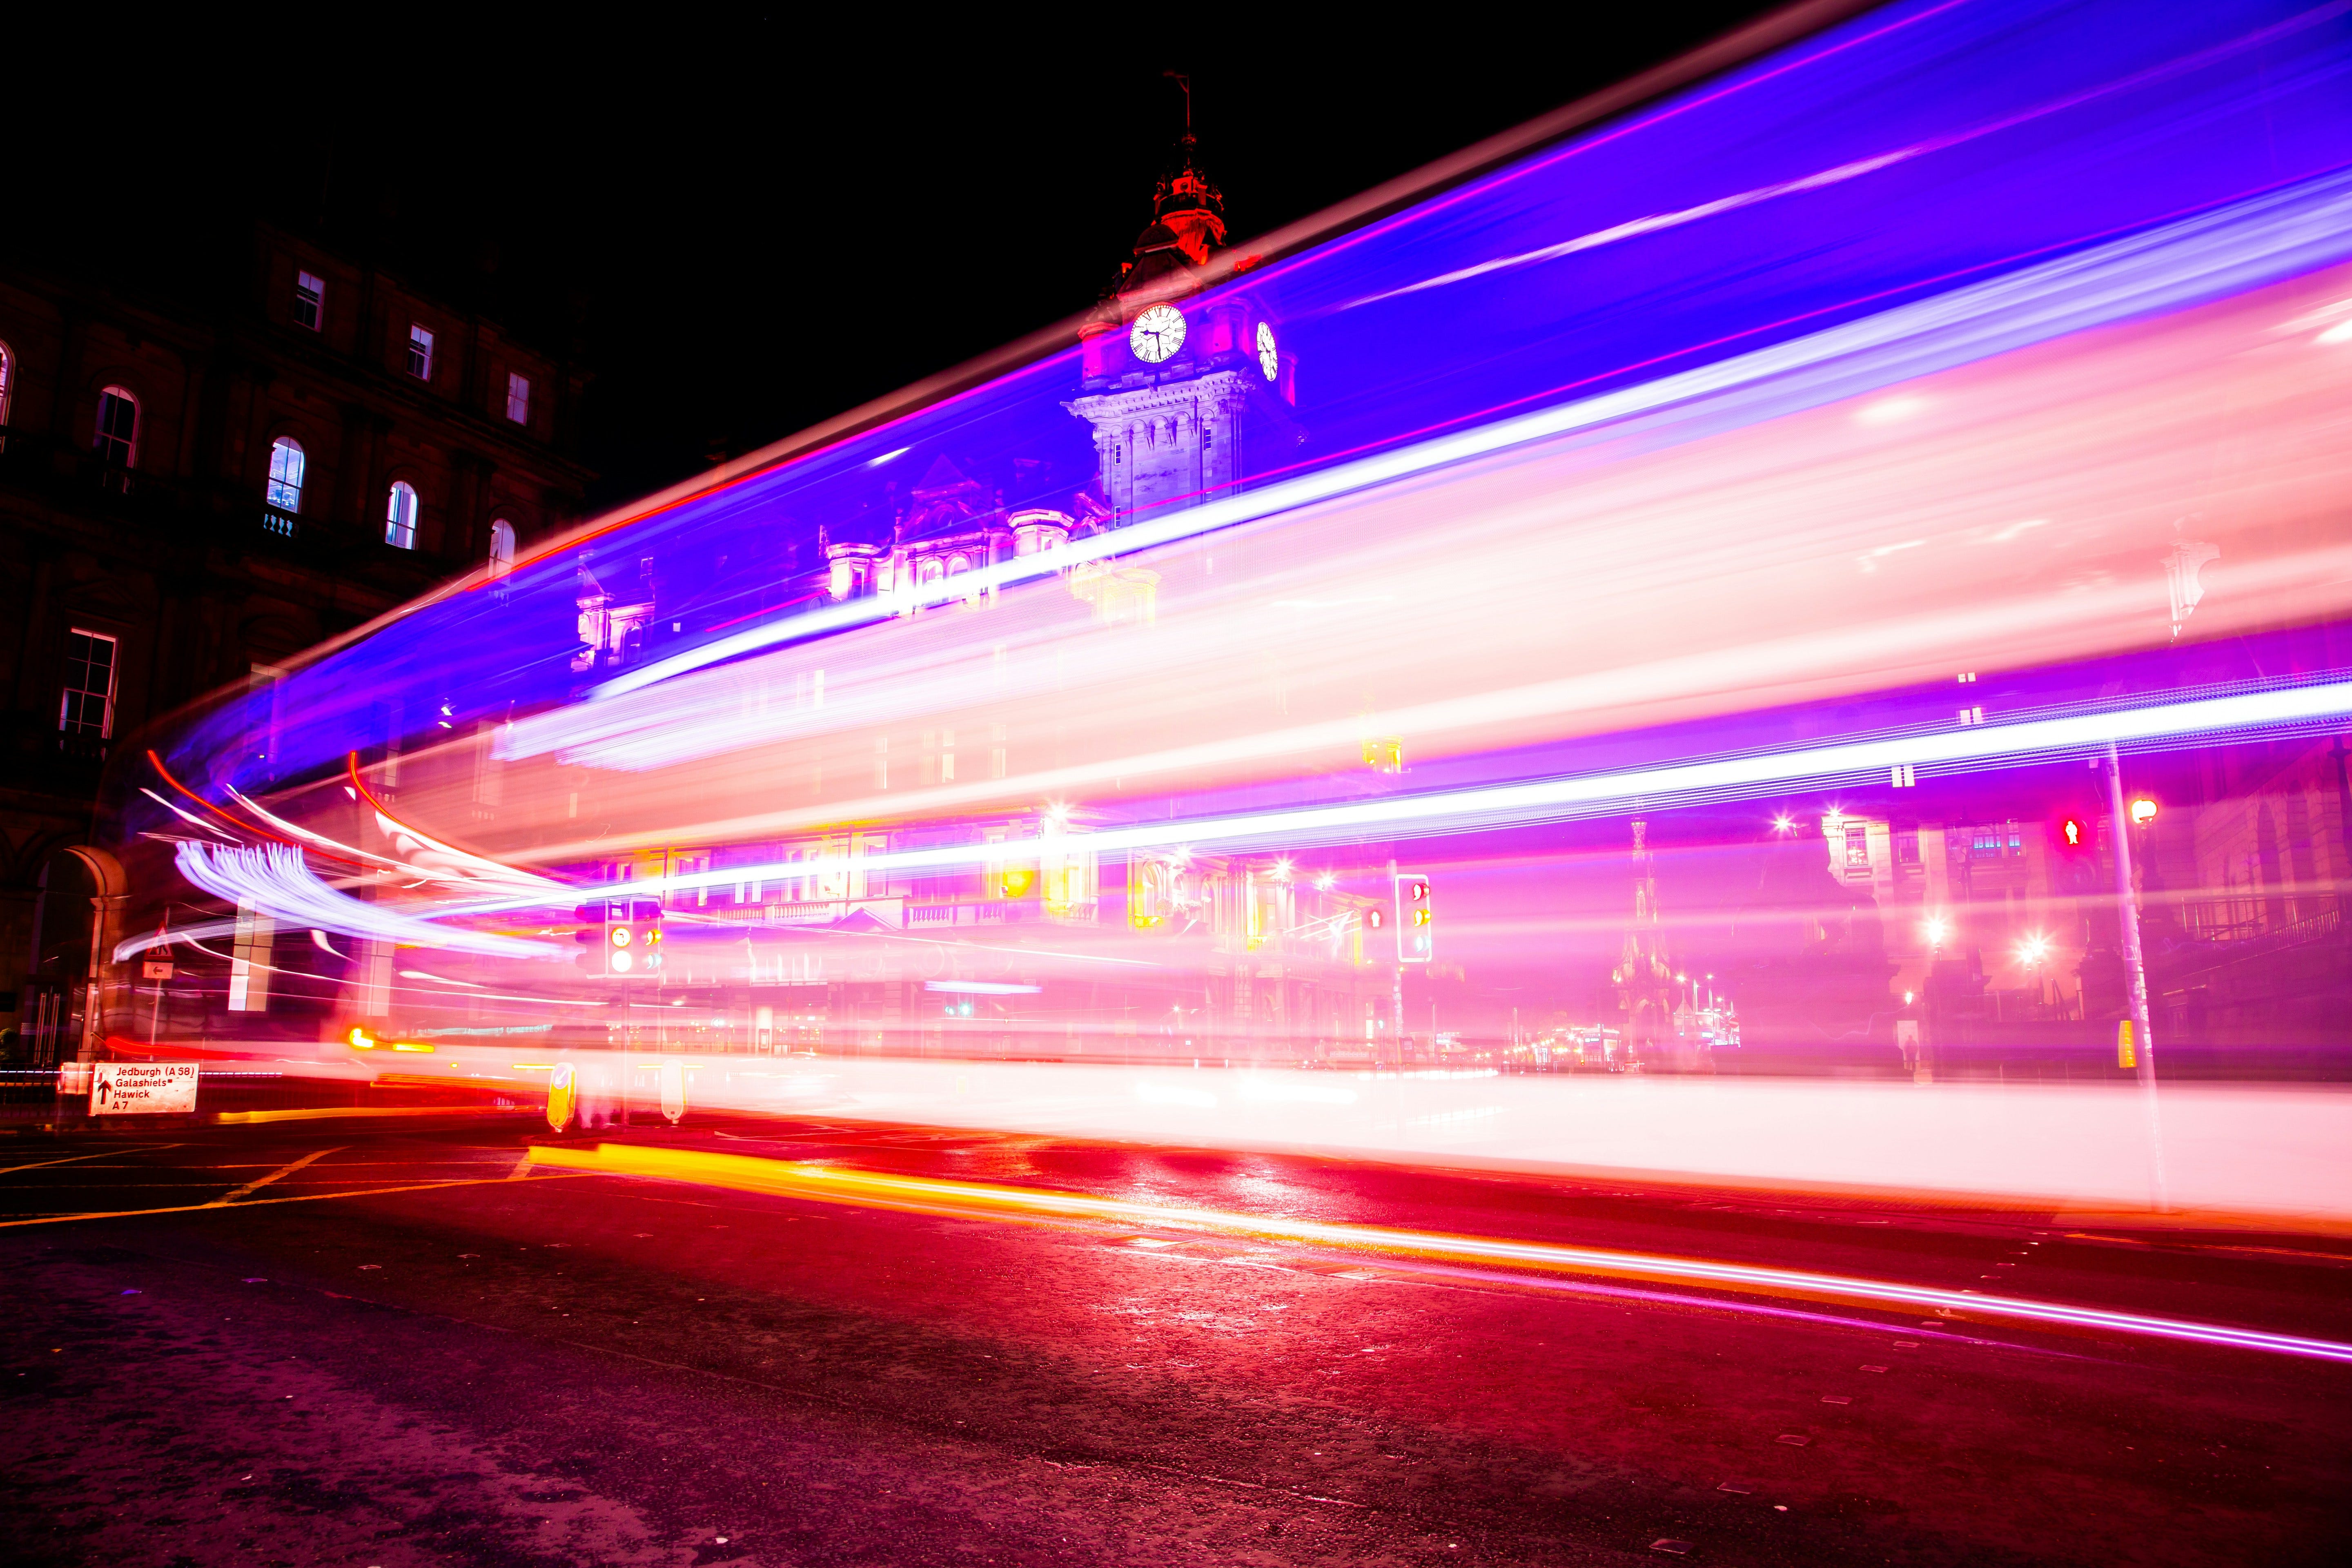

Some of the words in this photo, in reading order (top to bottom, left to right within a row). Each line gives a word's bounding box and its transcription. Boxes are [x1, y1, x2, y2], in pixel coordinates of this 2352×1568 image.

[116, 1067, 161, 1077] Jedburgh
[116, 1078, 167, 1087] Galashiels
[114, 1089, 149, 1098] Hawick
